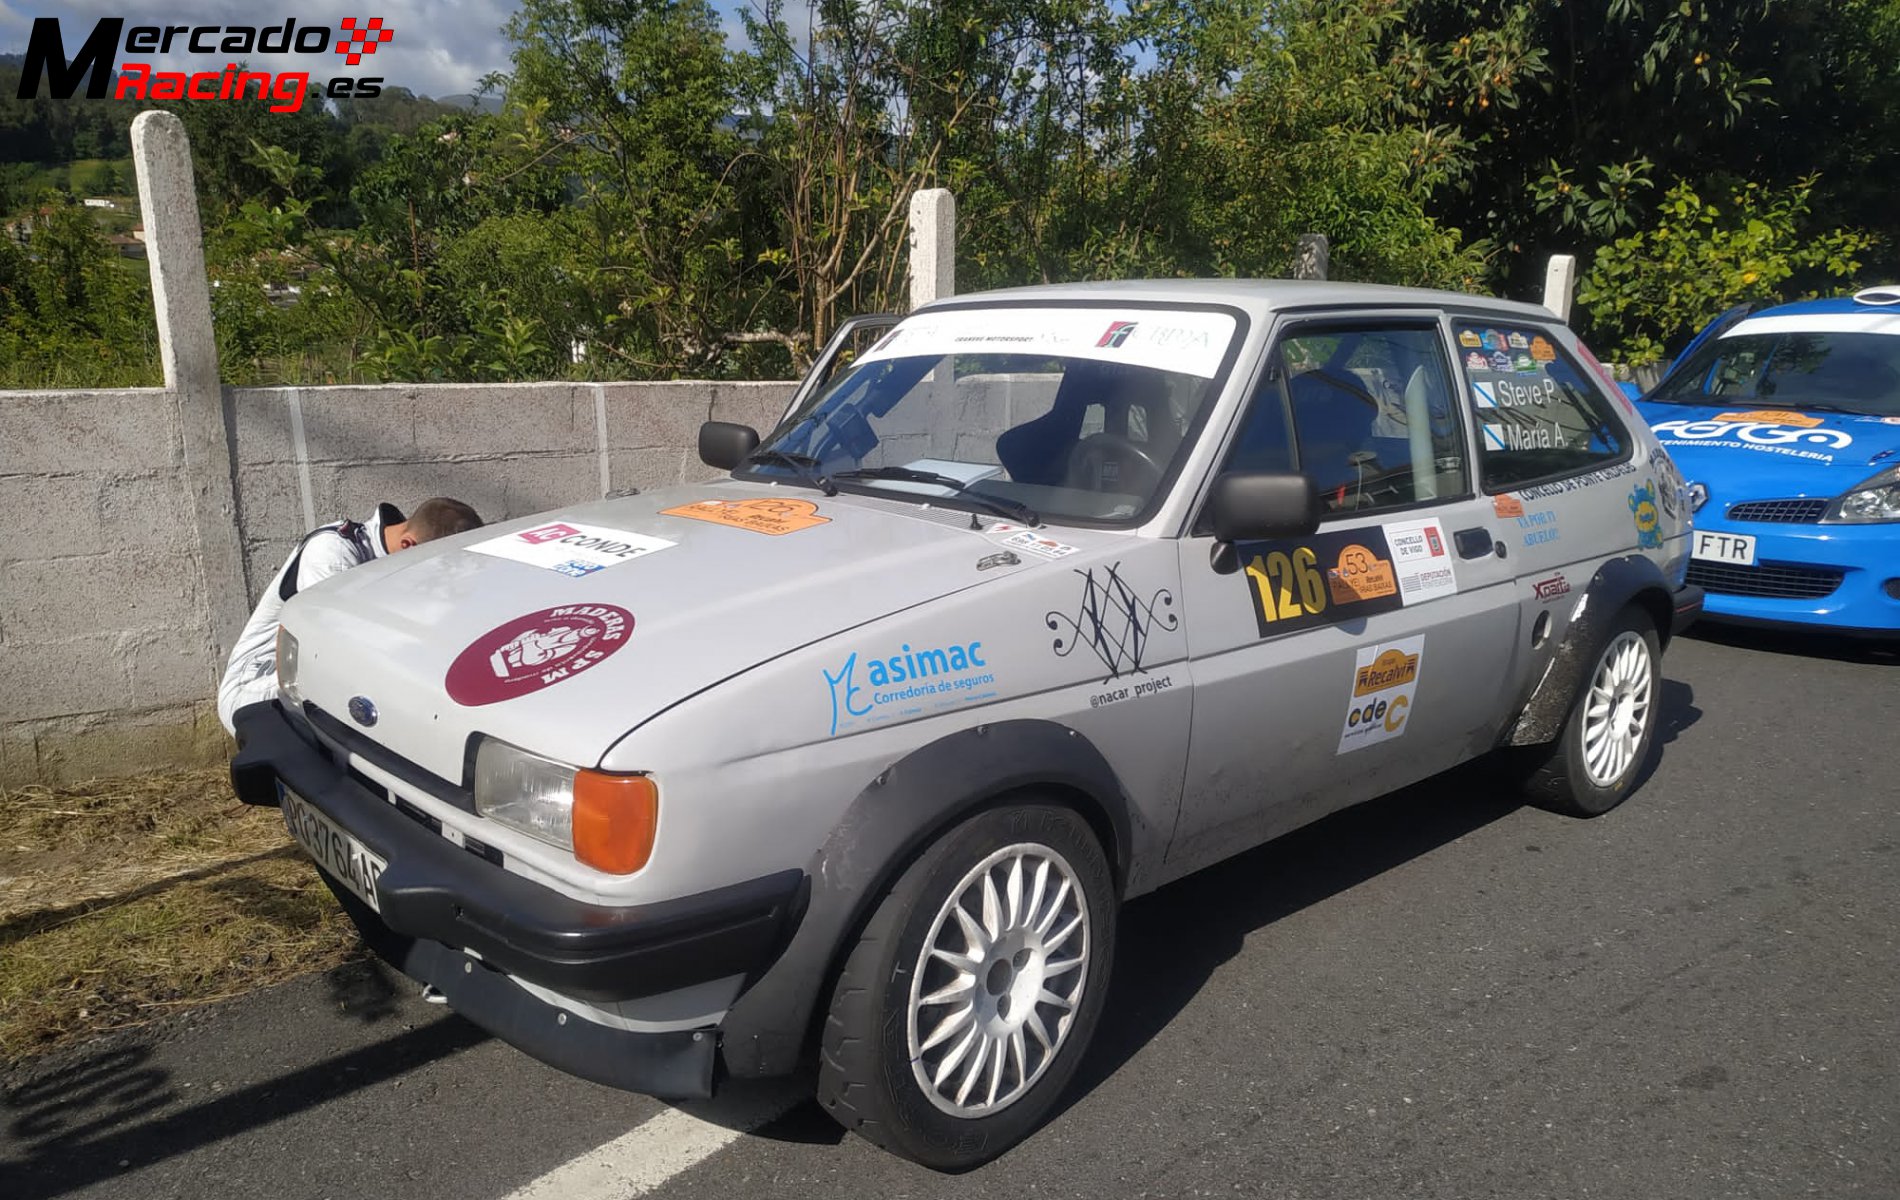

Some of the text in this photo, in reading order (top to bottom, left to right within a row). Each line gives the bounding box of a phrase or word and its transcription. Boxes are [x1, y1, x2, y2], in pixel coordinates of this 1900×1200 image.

[1498, 379, 1561, 407] Steve P.
[1507, 420, 1569, 451] María A.
[1657, 439, 1835, 463] TENIMIENTO HOSTELERIA
[560, 535, 646, 558] CONDE
[1394, 535, 1423, 547] CONCELLO
[1400, 546, 1410, 556] DE
[1699, 535, 1748, 560] FTR
[1345, 552, 1369, 575] 53
[1246, 547, 1328, 623] 126
[550, 606, 625, 640] MADERAS
[867, 641, 987, 687] asimac
[1367, 664, 1406, 687] Recalvi
[938, 679, 953, 692] de
[953, 673, 995, 691] seguros
[1090, 676, 1173, 708] @nacar_project
